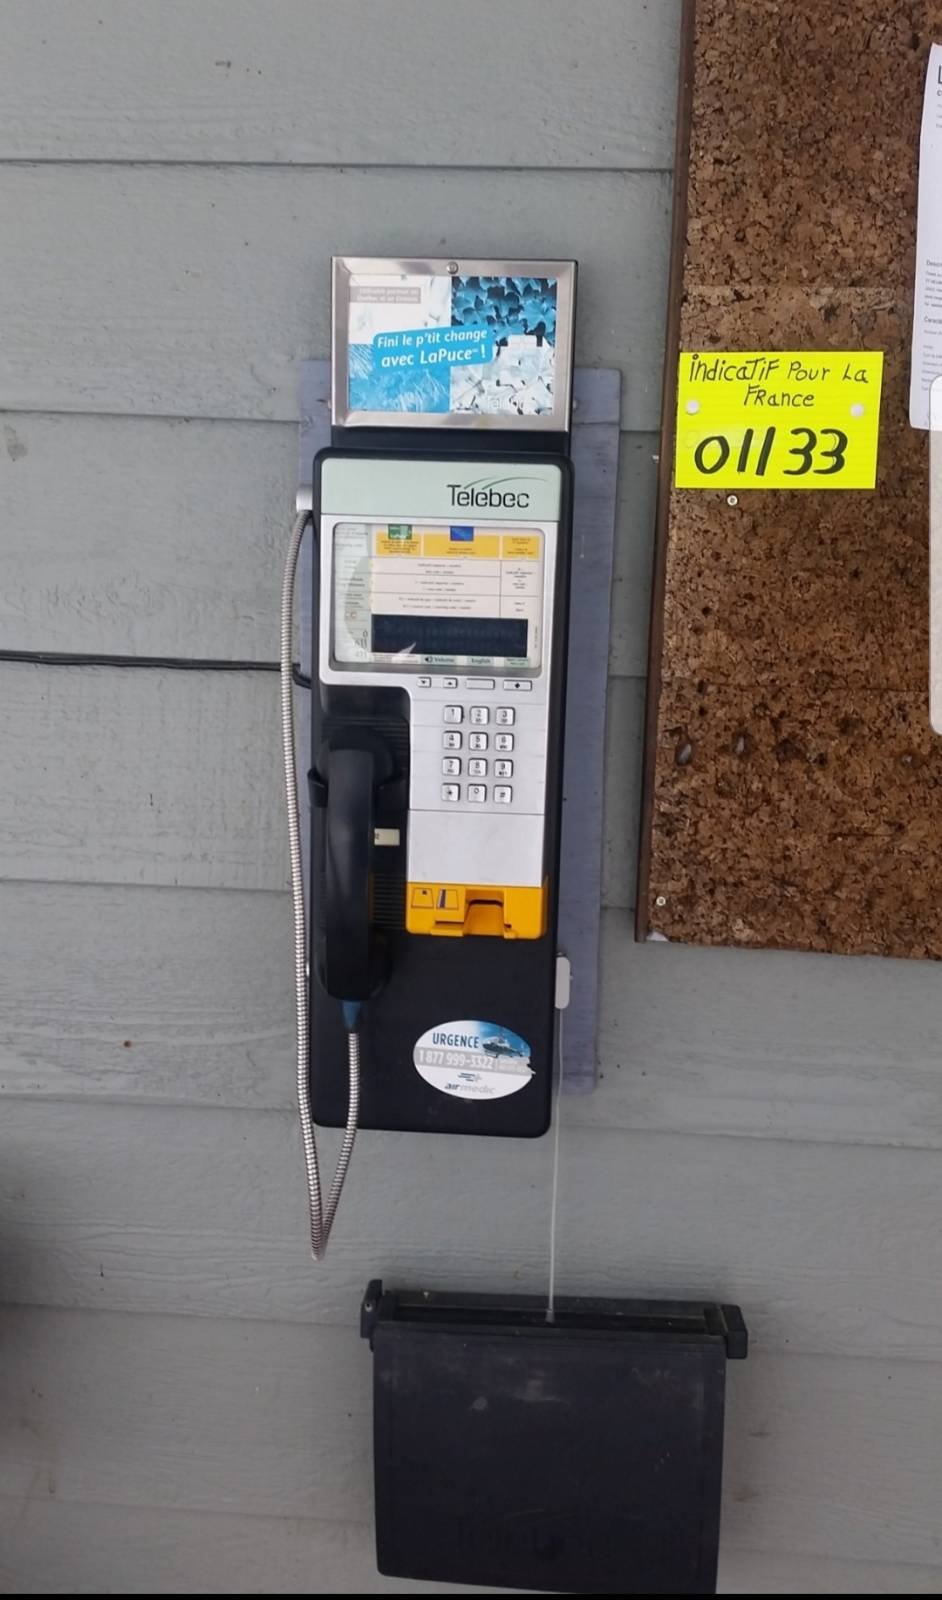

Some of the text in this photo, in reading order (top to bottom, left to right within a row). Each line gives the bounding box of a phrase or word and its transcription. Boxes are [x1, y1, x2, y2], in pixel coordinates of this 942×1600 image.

[377, 329, 488, 348] Fini le p'tit change
[381, 354, 415, 368] avec
[842, 363, 869, 384] La
[432, 1032, 480, 1049] URGENCE
